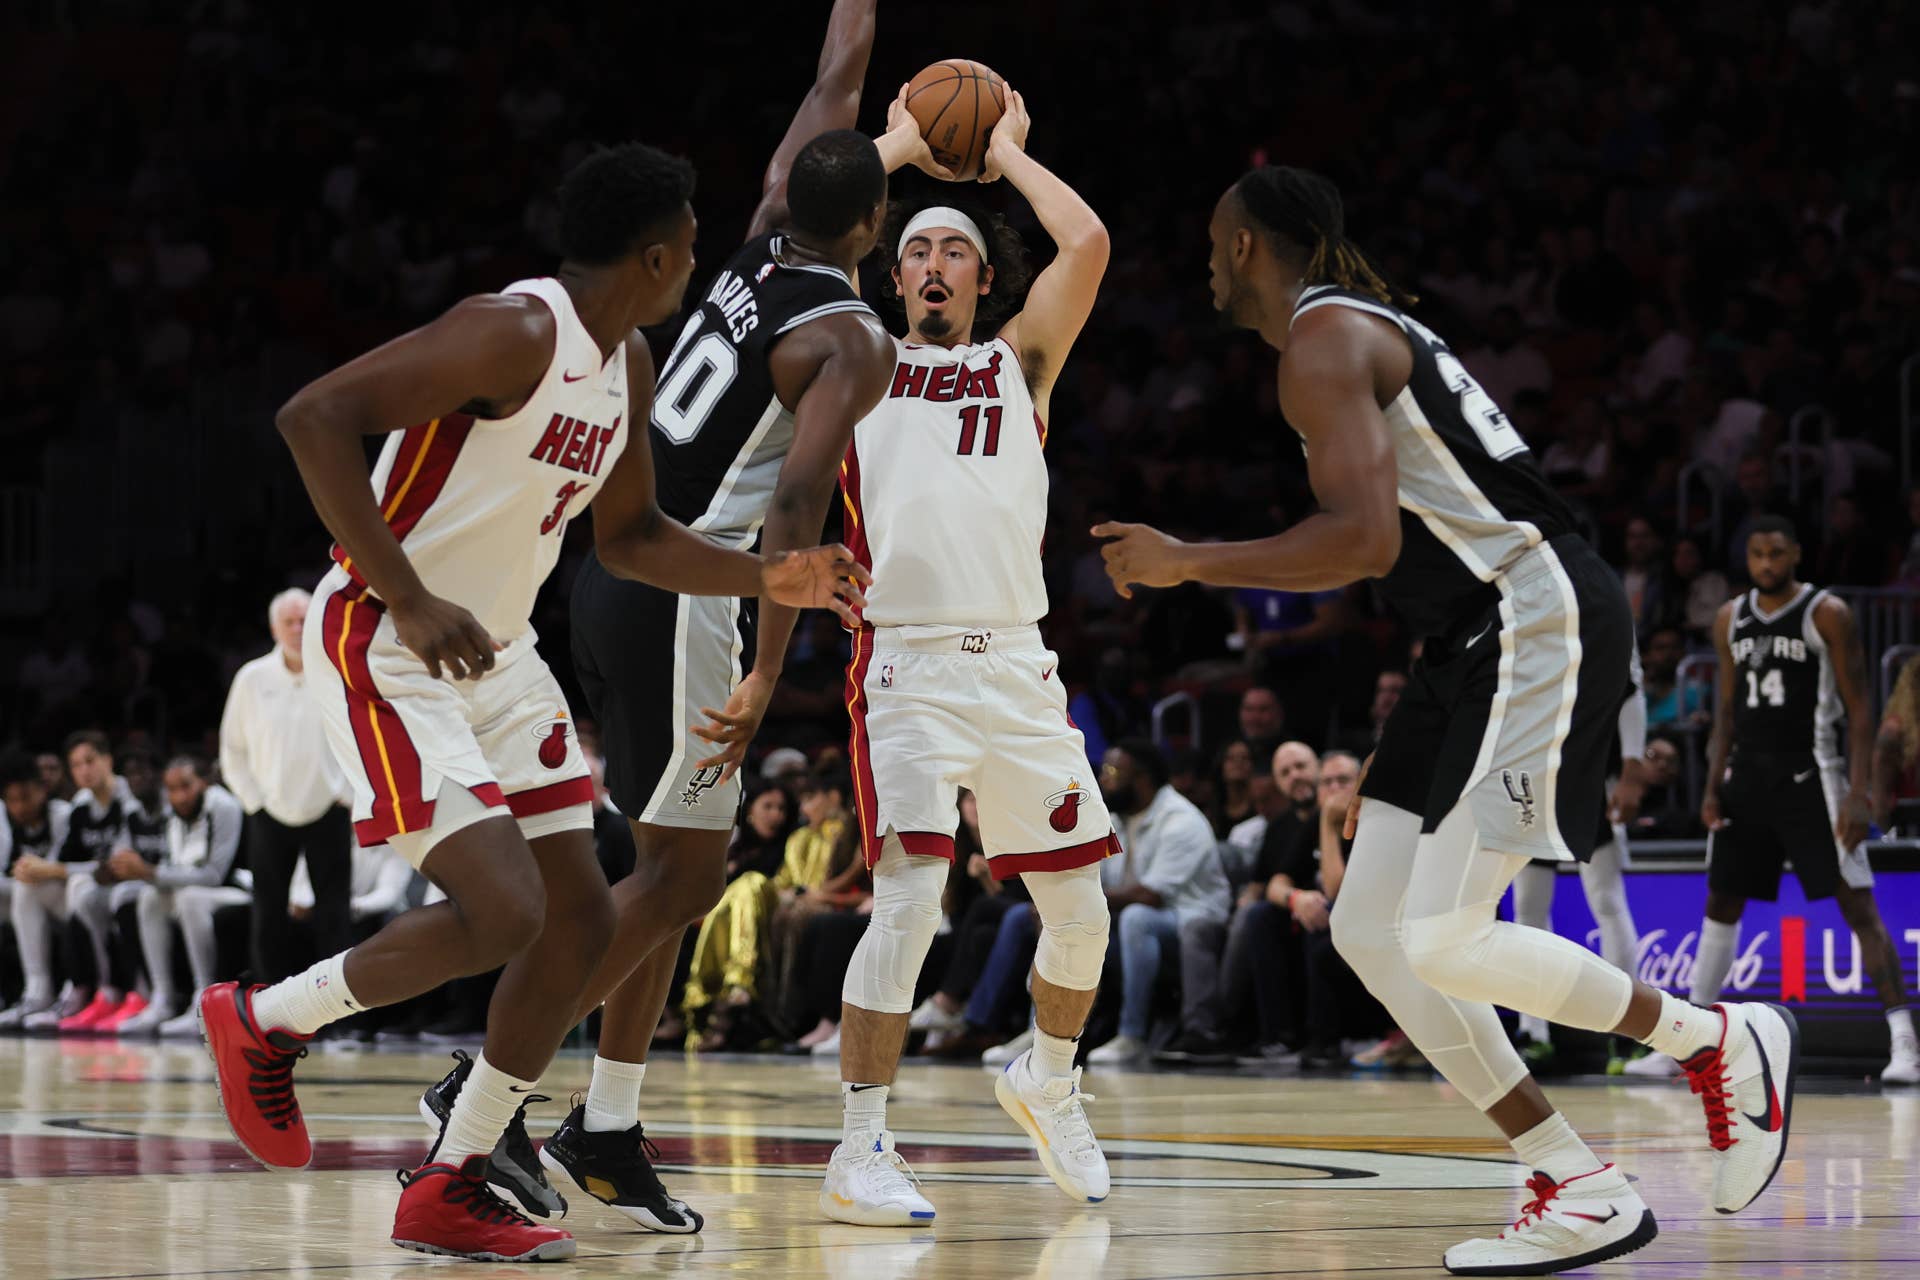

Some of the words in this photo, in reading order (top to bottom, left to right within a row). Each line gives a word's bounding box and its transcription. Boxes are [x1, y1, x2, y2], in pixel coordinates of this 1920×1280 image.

[706, 269, 759, 344] ARNES
[889, 350, 1003, 402] HEAT
[529, 409, 622, 477] HEAT
[957, 404, 1003, 456] 11
[1745, 668, 1785, 708] 14
